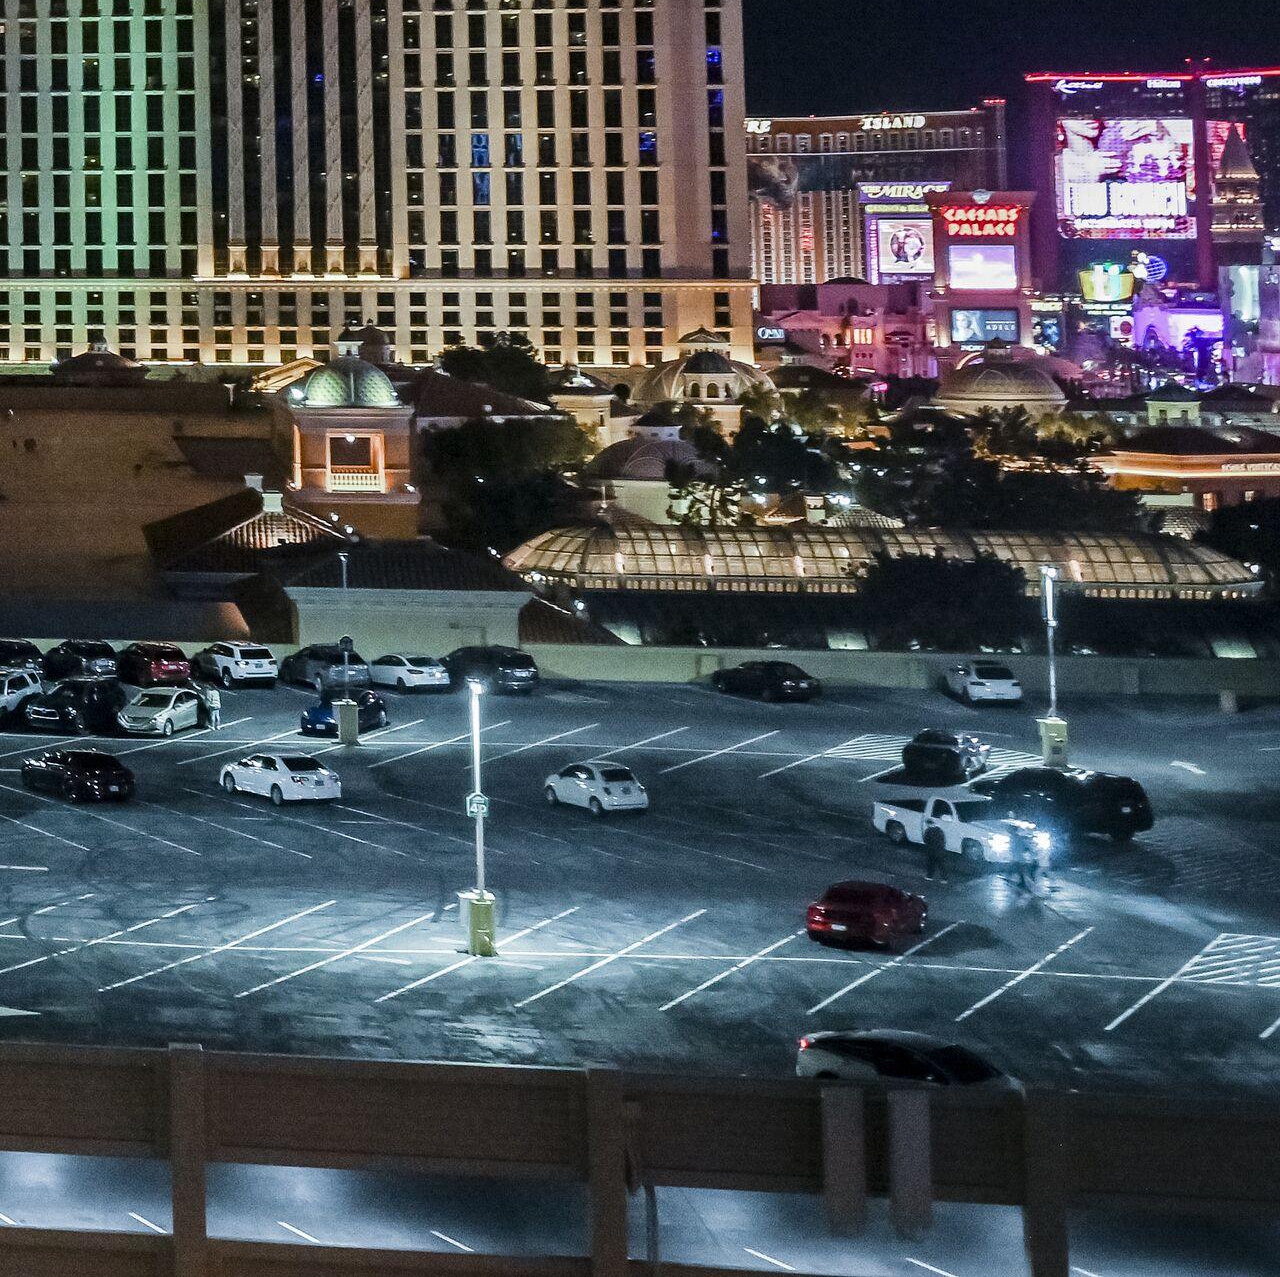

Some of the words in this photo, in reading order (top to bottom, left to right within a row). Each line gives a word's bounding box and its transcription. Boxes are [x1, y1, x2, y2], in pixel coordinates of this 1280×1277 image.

[862, 116, 926, 130] ISLAND
[943, 208, 1019, 222] CAESARS
[948, 223, 1015, 236] PALACE
